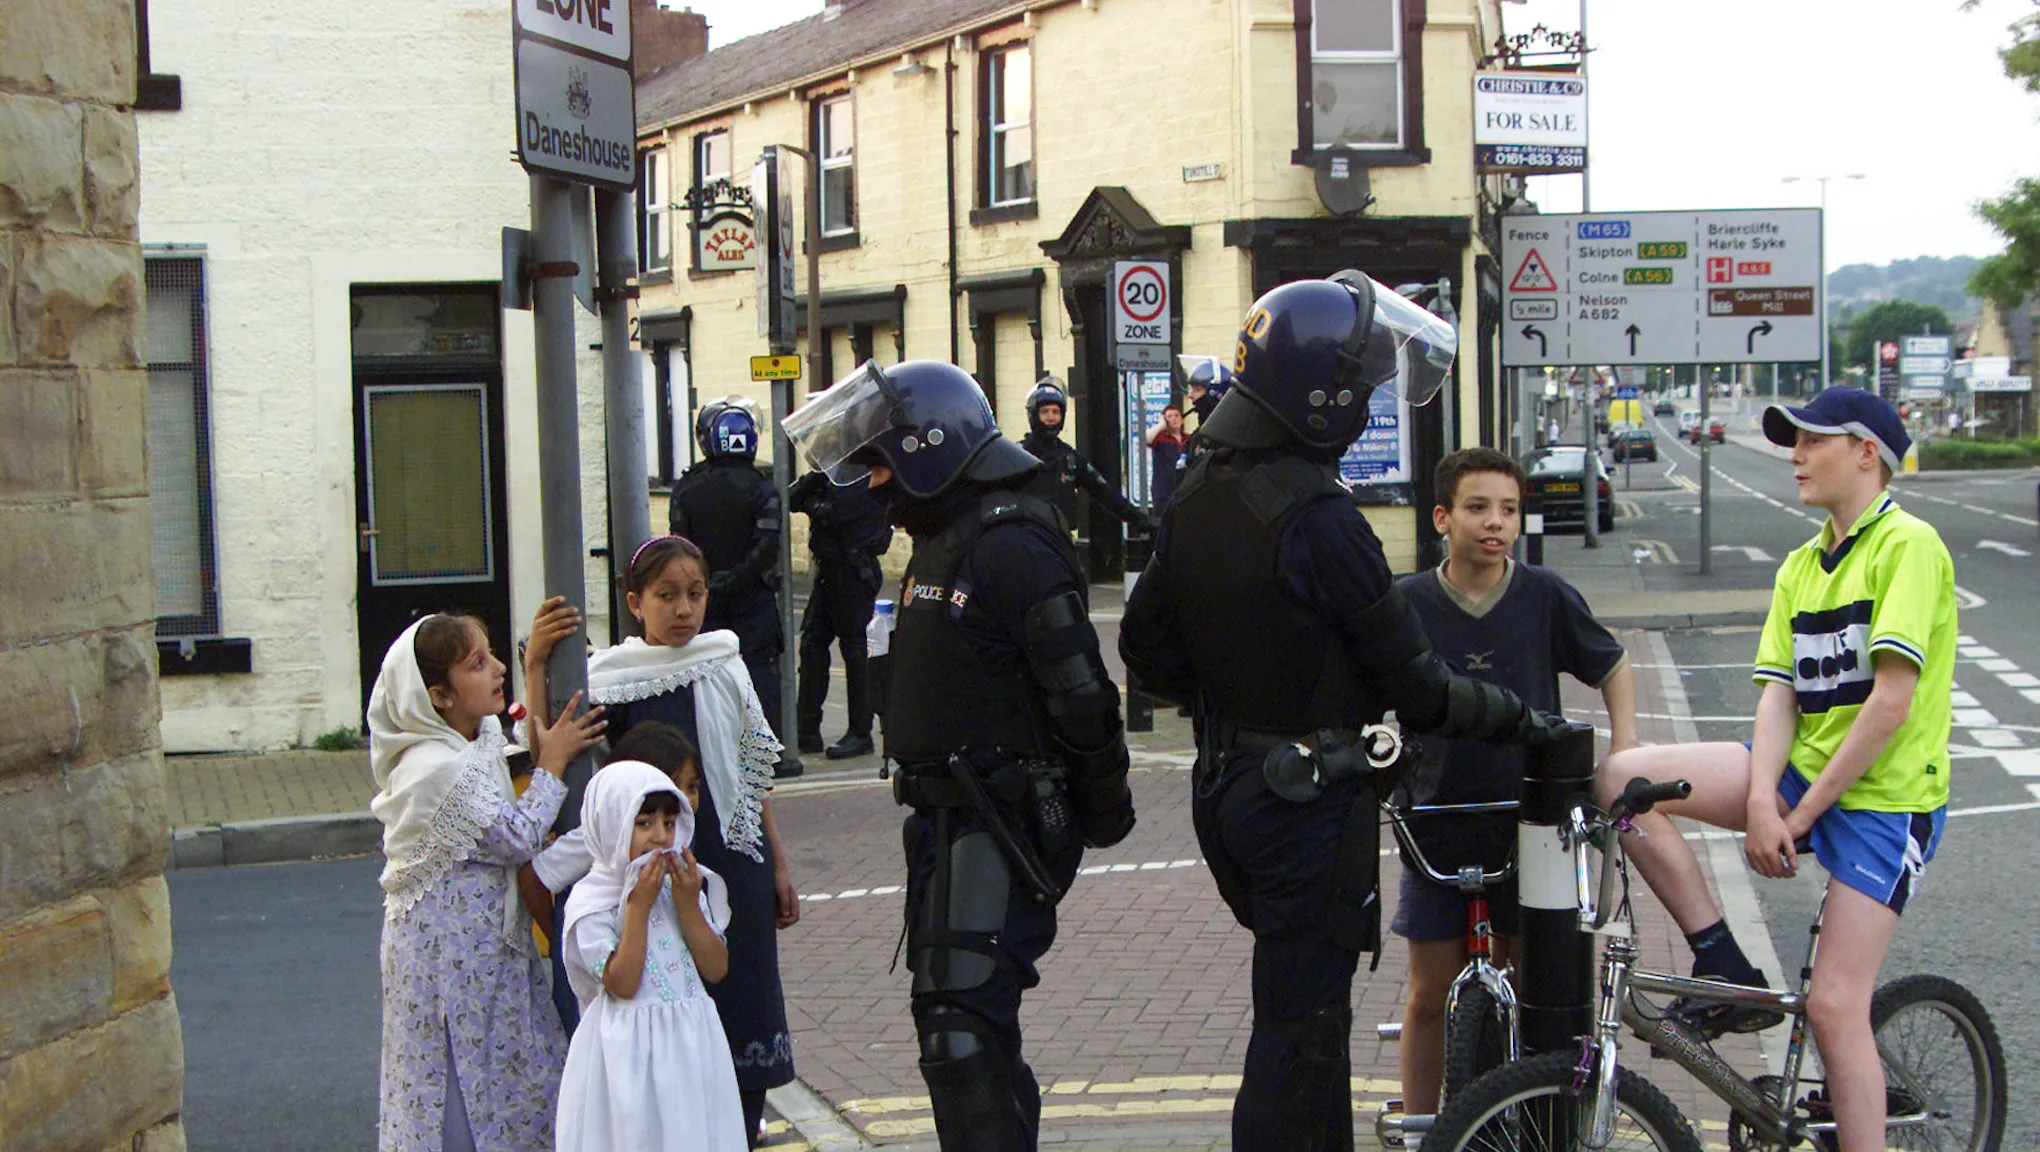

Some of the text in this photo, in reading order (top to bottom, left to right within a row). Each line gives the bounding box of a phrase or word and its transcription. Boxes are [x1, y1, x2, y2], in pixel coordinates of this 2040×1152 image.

[536, 0, 613, 35] NE
[1480, 80, 1547, 94] CHRISTIE
[1486, 111, 1578, 132] FOR SALE
[526, 111, 630, 172] Daneshouse
[1508, 229, 1549, 241] Fence
[1708, 222, 1780, 236] Briercliffe
[705, 227, 755, 252] TETLEY
[1708, 237, 1786, 251] Harle Syke
[717, 249, 744, 261] ALES
[1579, 246, 1633, 259] Skipton
[1579, 271, 1619, 284] Colne
[1126, 282, 1160, 306] 20
[1579, 294, 1628, 307] Nelson
[1775, 289, 1811, 301] Street
[1528, 306, 1551, 315] mile
[1579, 308, 1620, 320] A682
[1761, 302, 1785, 313] Mill
[630, 317, 640, 342] 2
[1125, 325, 1162, 339] ZONE
[780, 369, 799, 377] time
[914, 584, 944, 601] POLICE
